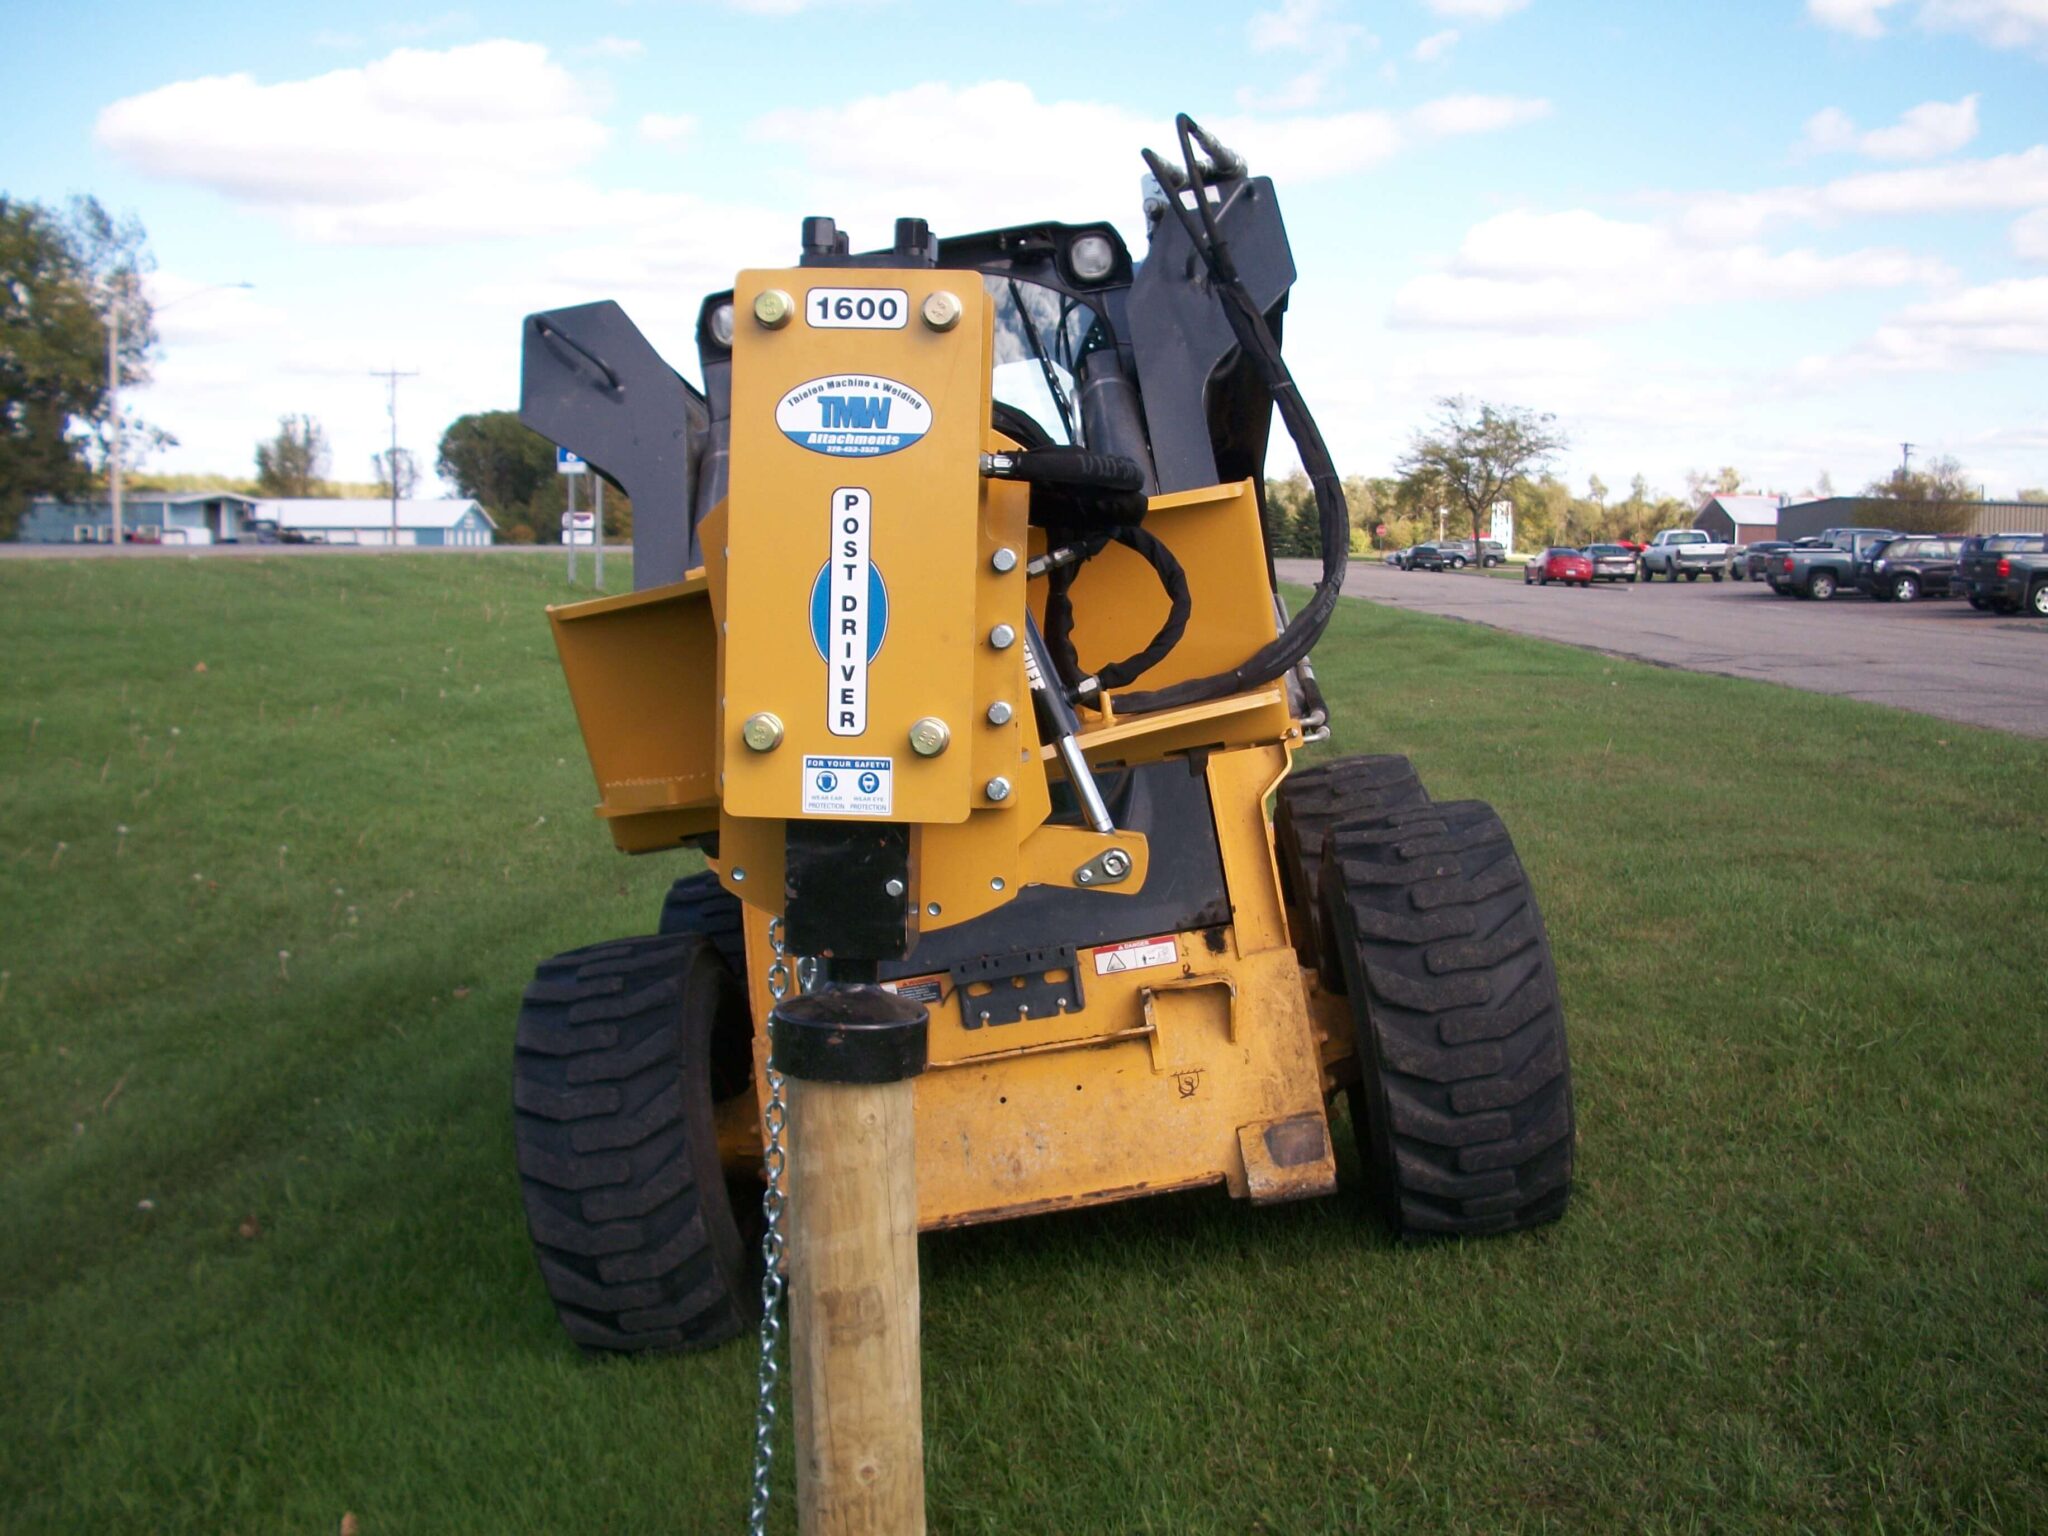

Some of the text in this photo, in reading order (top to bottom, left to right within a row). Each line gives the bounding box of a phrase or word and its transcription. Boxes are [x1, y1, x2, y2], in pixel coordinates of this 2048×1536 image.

[816, 296, 898, 321] 1600
[826, 378, 870, 389] Machine
[872, 381, 880, 390] &
[882, 382, 922, 410] Welding
[817, 395, 892, 430] TMW
[806, 432, 900, 446] Attachments
[840, 494, 859, 728] POST DRIVER
[807, 759, 889, 769] FOR YOUR SAFETY!
[808, 802, 845, 810] PROTECTION
[850, 803, 887, 811] PROTECTION
